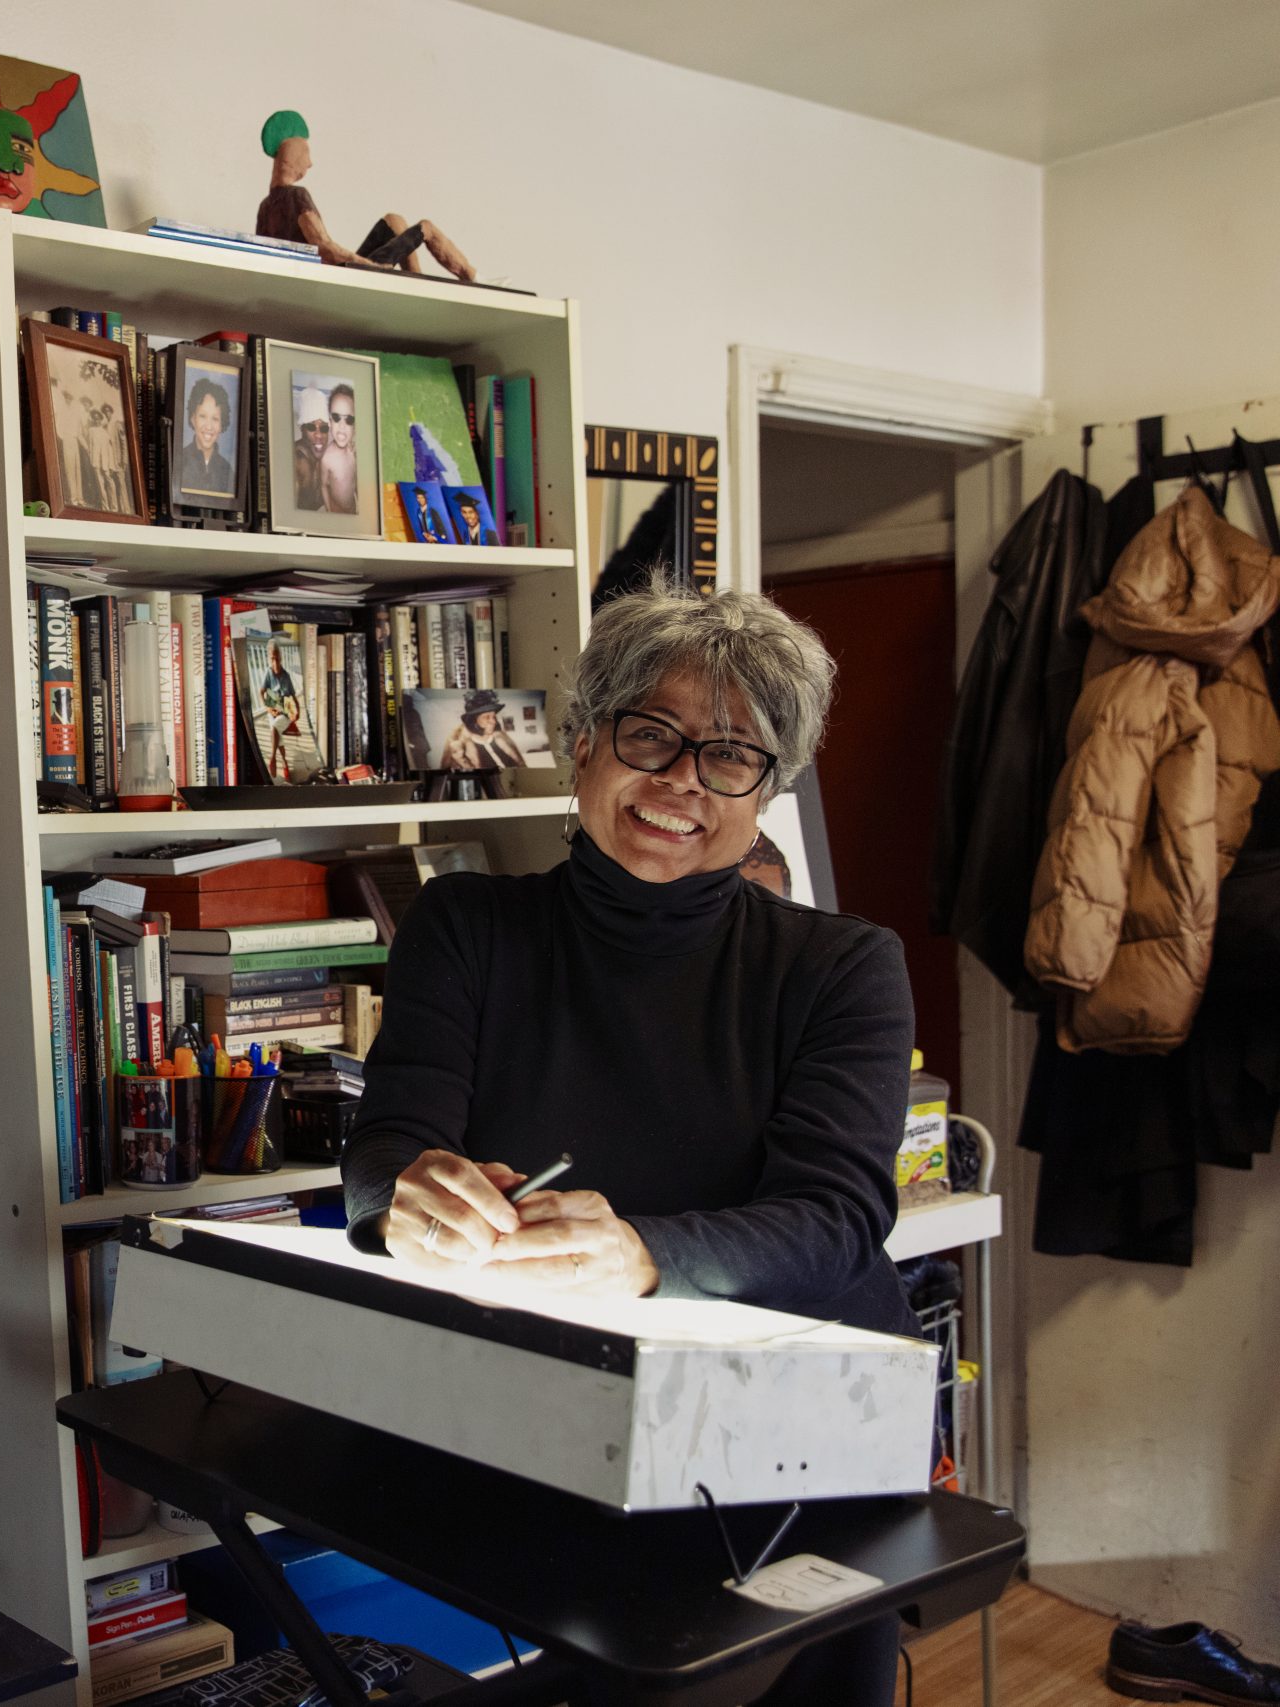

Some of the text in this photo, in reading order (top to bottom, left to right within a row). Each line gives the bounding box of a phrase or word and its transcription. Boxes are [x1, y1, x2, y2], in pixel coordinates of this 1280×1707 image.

[47, 599, 66, 671] MONK
[64, 600, 73, 670] THELONIOUS
[90, 627, 101, 690] PAUL MOONEY
[157, 601, 170, 659] BLIND
[191, 603, 203, 676] TWO NATIONS
[432, 621, 443, 680] LEVELING
[171, 627, 182, 724] REAL AMERICAN
[193, 693, 203, 735] ANDREW
[92, 695, 106, 796] BLACK IS THE NEW WHI
[63, 961, 71, 1010] PROMISES
[75, 946, 83, 992] ROBINSON
[123, 984, 137, 1060] FIRST CLASS
[230, 997, 283, 1012] BLACK ENGLISH
[51, 977, 65, 1099] TESTING THE ICE
[77, 1008, 88, 1085] THE TEACHINGS
[108, 1580, 140, 1596] G2
[105, 1622, 120, 1635] Sign
[93, 1677, 132, 1697] KORAN
